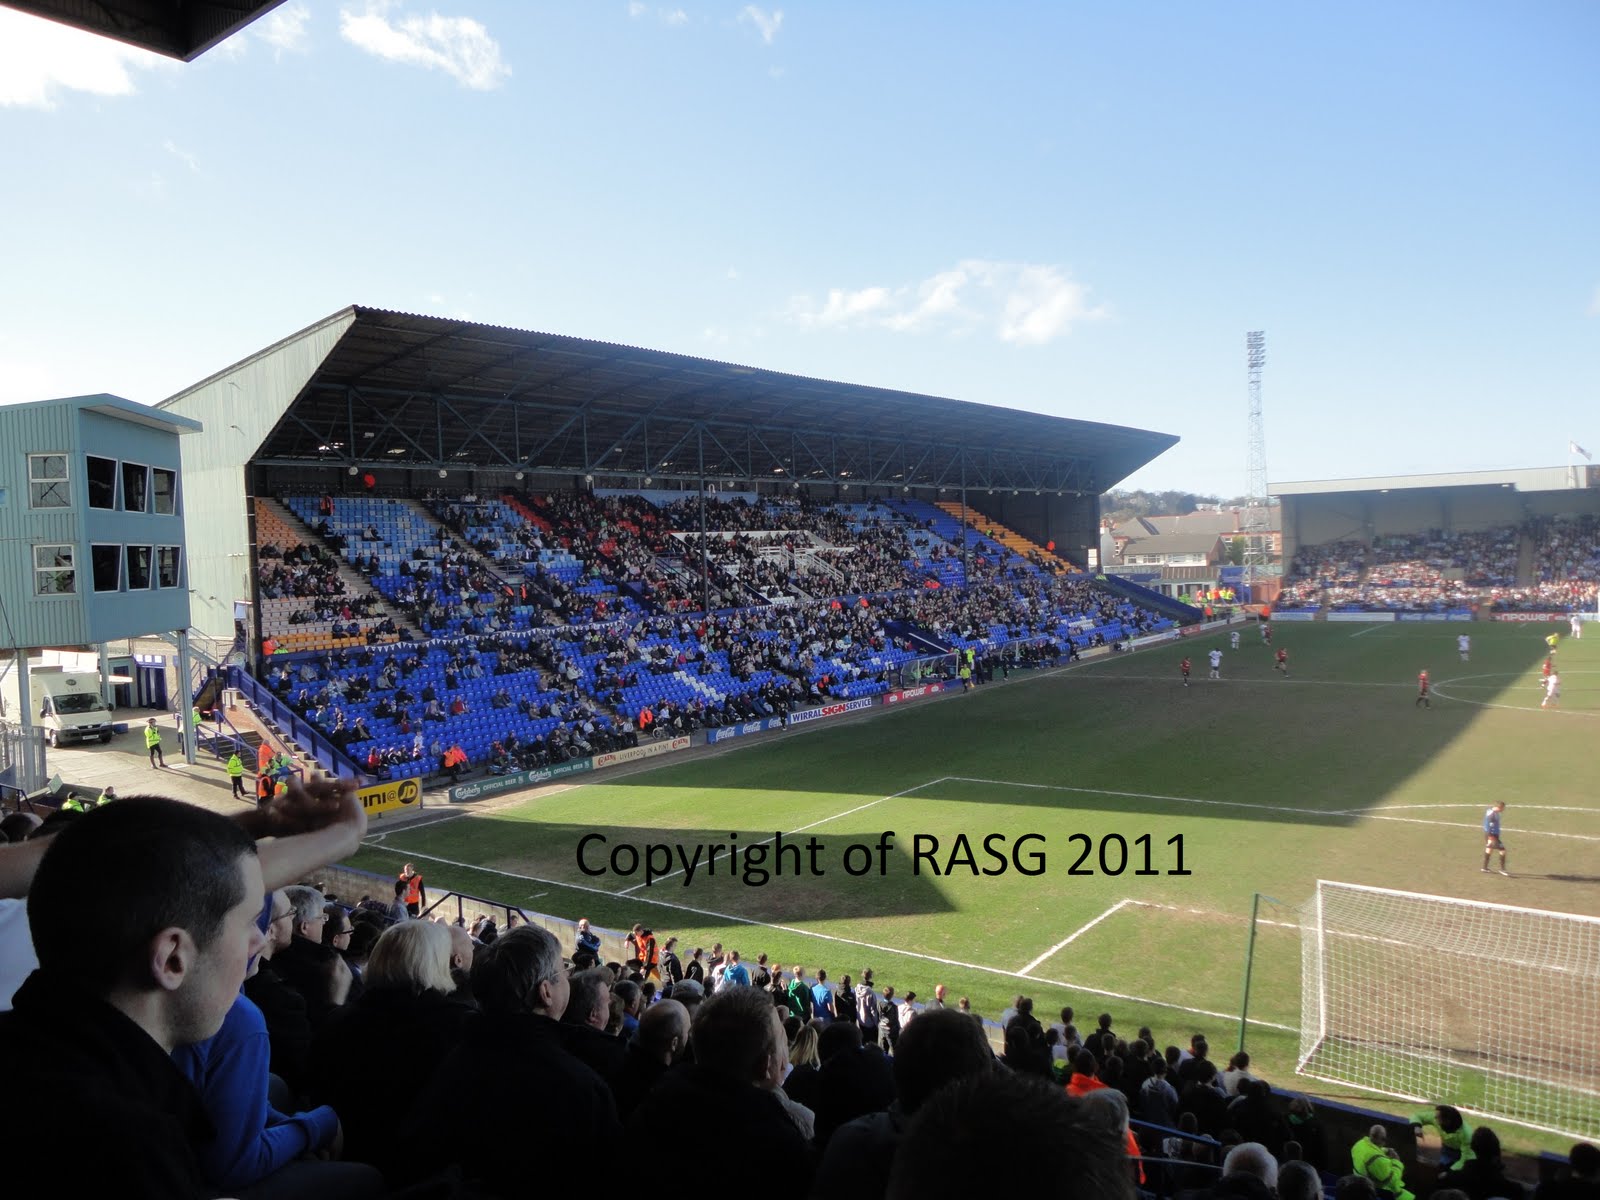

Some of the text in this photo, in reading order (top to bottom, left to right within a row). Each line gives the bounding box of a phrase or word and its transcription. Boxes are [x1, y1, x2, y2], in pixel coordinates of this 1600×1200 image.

[454, 784, 481, 800] Carlsberg
[482, 781, 504, 791] OFFICIAL
[528, 767, 552, 782] Carlsberg
